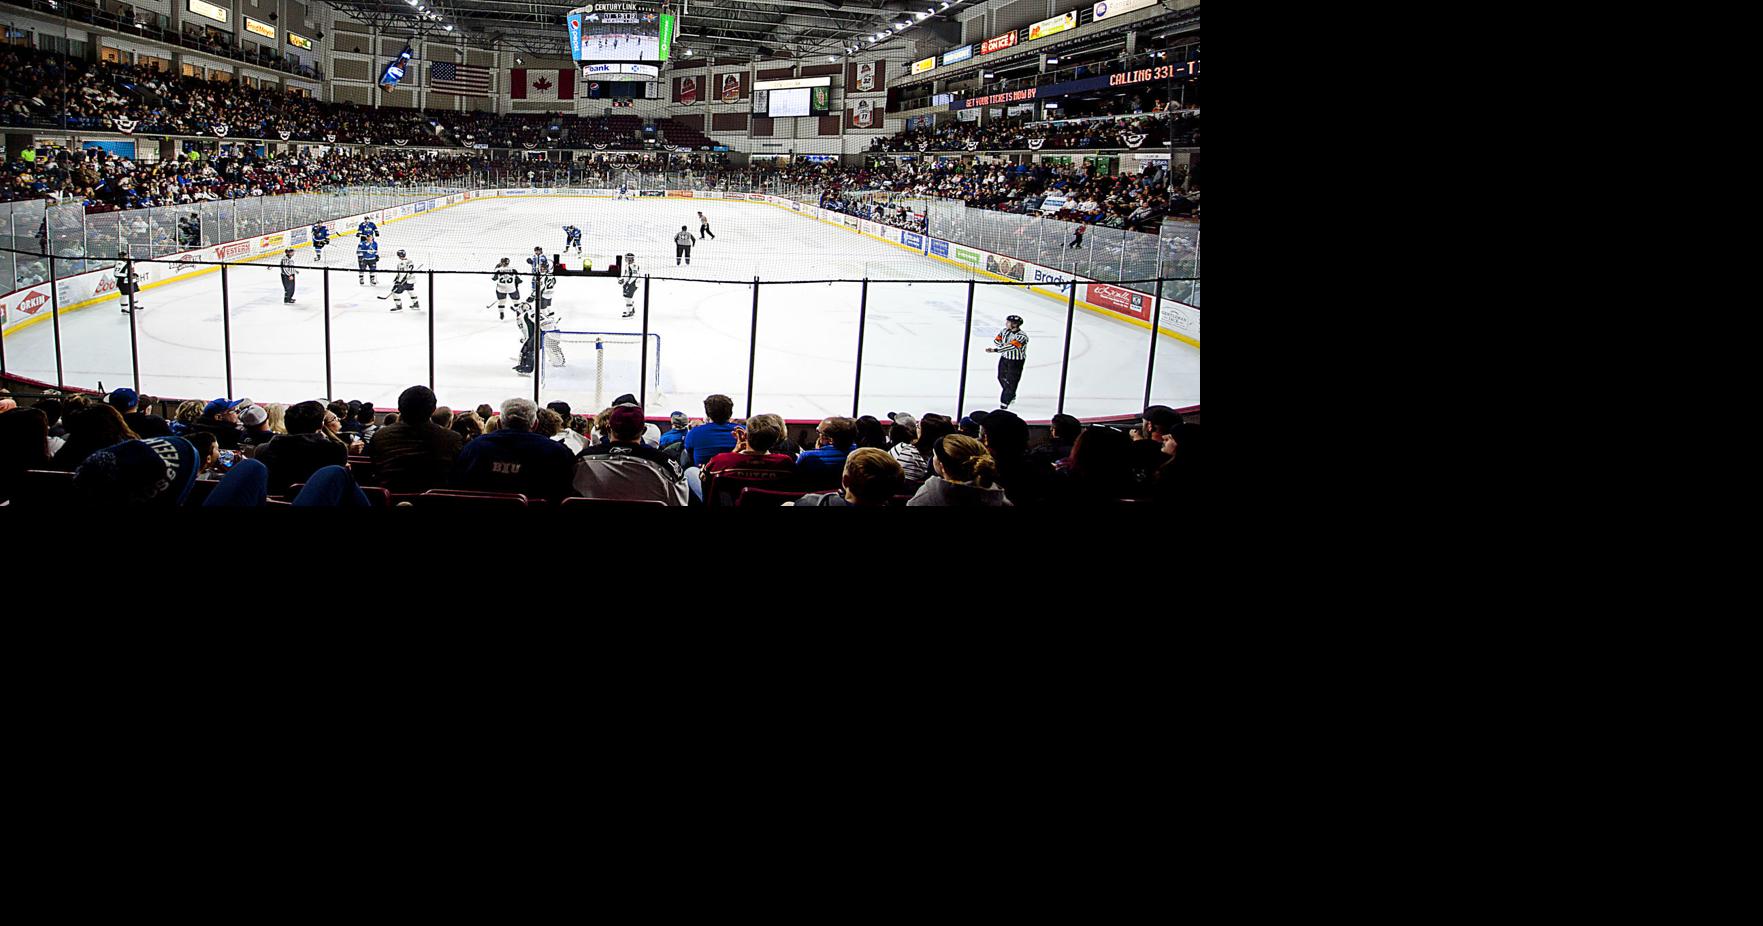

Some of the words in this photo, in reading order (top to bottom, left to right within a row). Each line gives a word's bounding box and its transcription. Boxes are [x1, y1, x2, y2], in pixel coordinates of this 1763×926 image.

[594, 3, 622, 11] CENTURY
[622, 3, 638, 11] LINK
[988, 40, 998, 50] ON
[998, 38, 1009, 47] ICE
[1109, 68, 1152, 86] CALLING
[1153, 64, 1175, 79] 331
[965, 98, 975, 108] GET
[976, 96, 989, 107] YOUR
[989, 92, 1013, 104] TICKETS
[1013, 89, 1027, 101] NOW
[1027, 87, 1037, 99] BY
[215, 241, 251, 259] WESTERN
[1034, 270, 1072, 293] Brady
[20, 294, 46, 312] ORKIN
